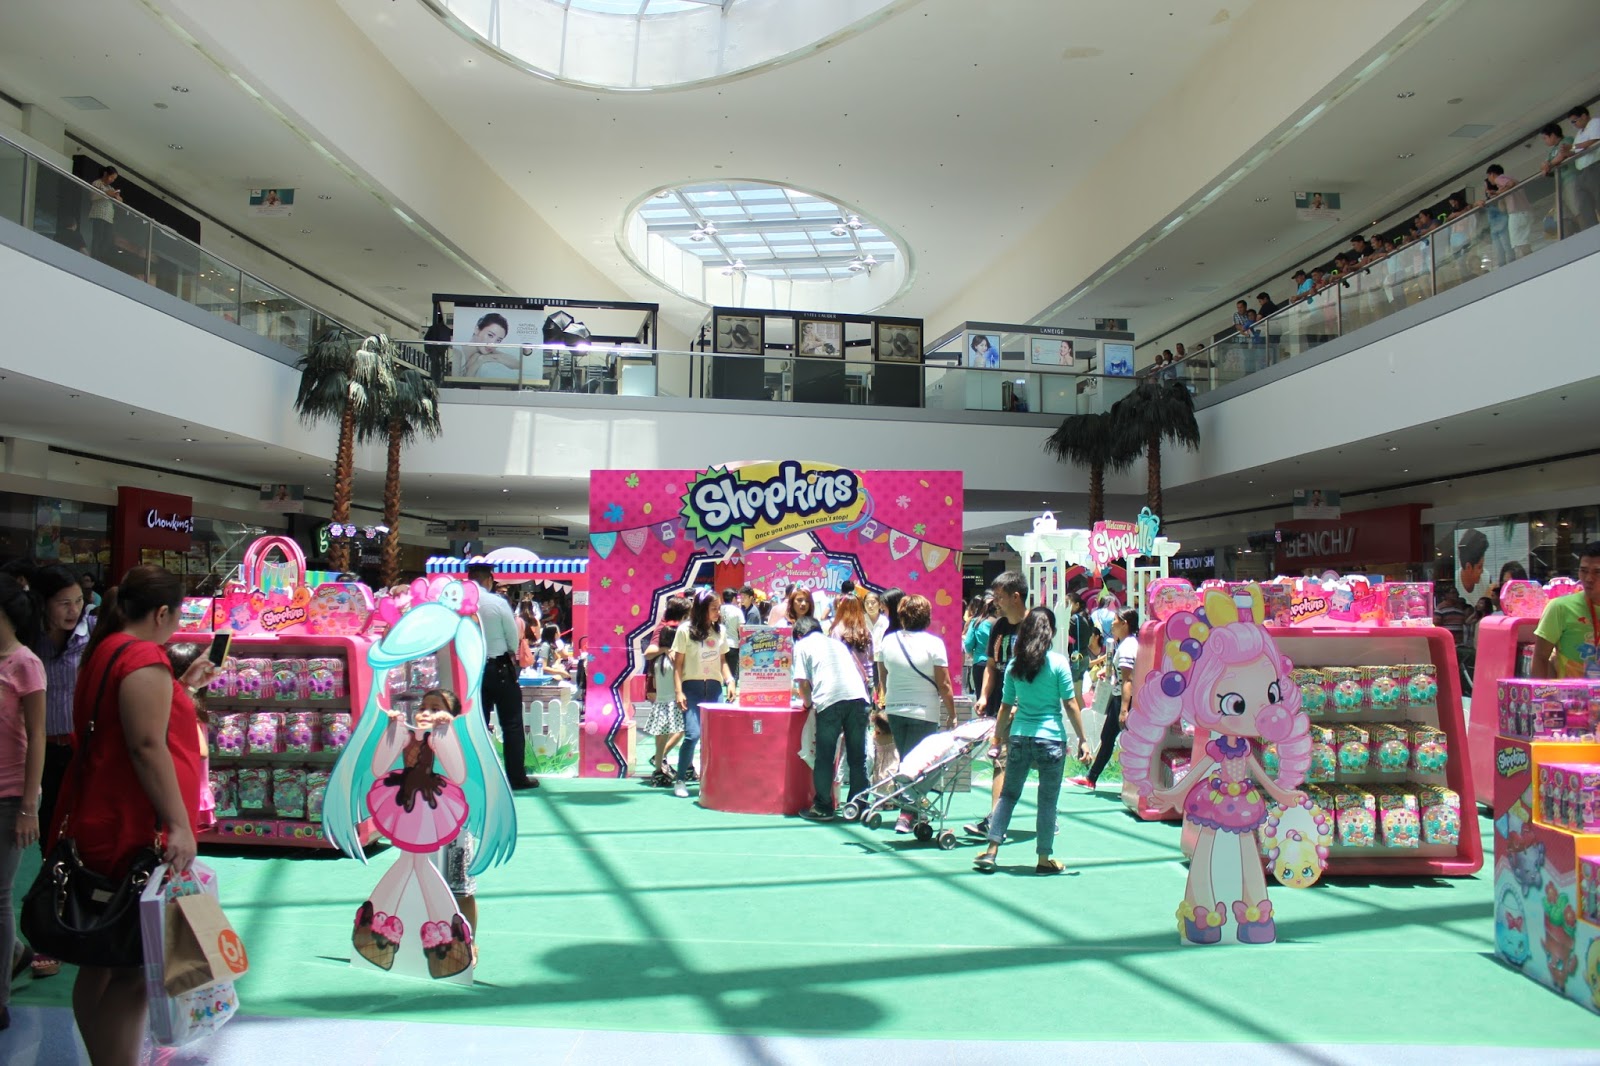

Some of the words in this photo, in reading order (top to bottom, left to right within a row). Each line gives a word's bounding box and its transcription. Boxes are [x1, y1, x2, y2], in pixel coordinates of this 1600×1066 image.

[1040, 327, 1065, 335] LANEIGE
[695, 466, 852, 527] Shopkins
[754, 531, 771, 540] Once
[771, 527, 783, 535] you
[815, 515, 832, 523] can't
[1105, 520, 1126, 531] Welcome
[1126, 523, 1132, 531] to
[1092, 520, 1153, 563] Shopville
[1172, 559, 1184, 570] THE
[1185, 556, 1202, 569] BODY
[263, 606, 304, 626] Shopkins
[1498, 749, 1526, 769] Shopkins
